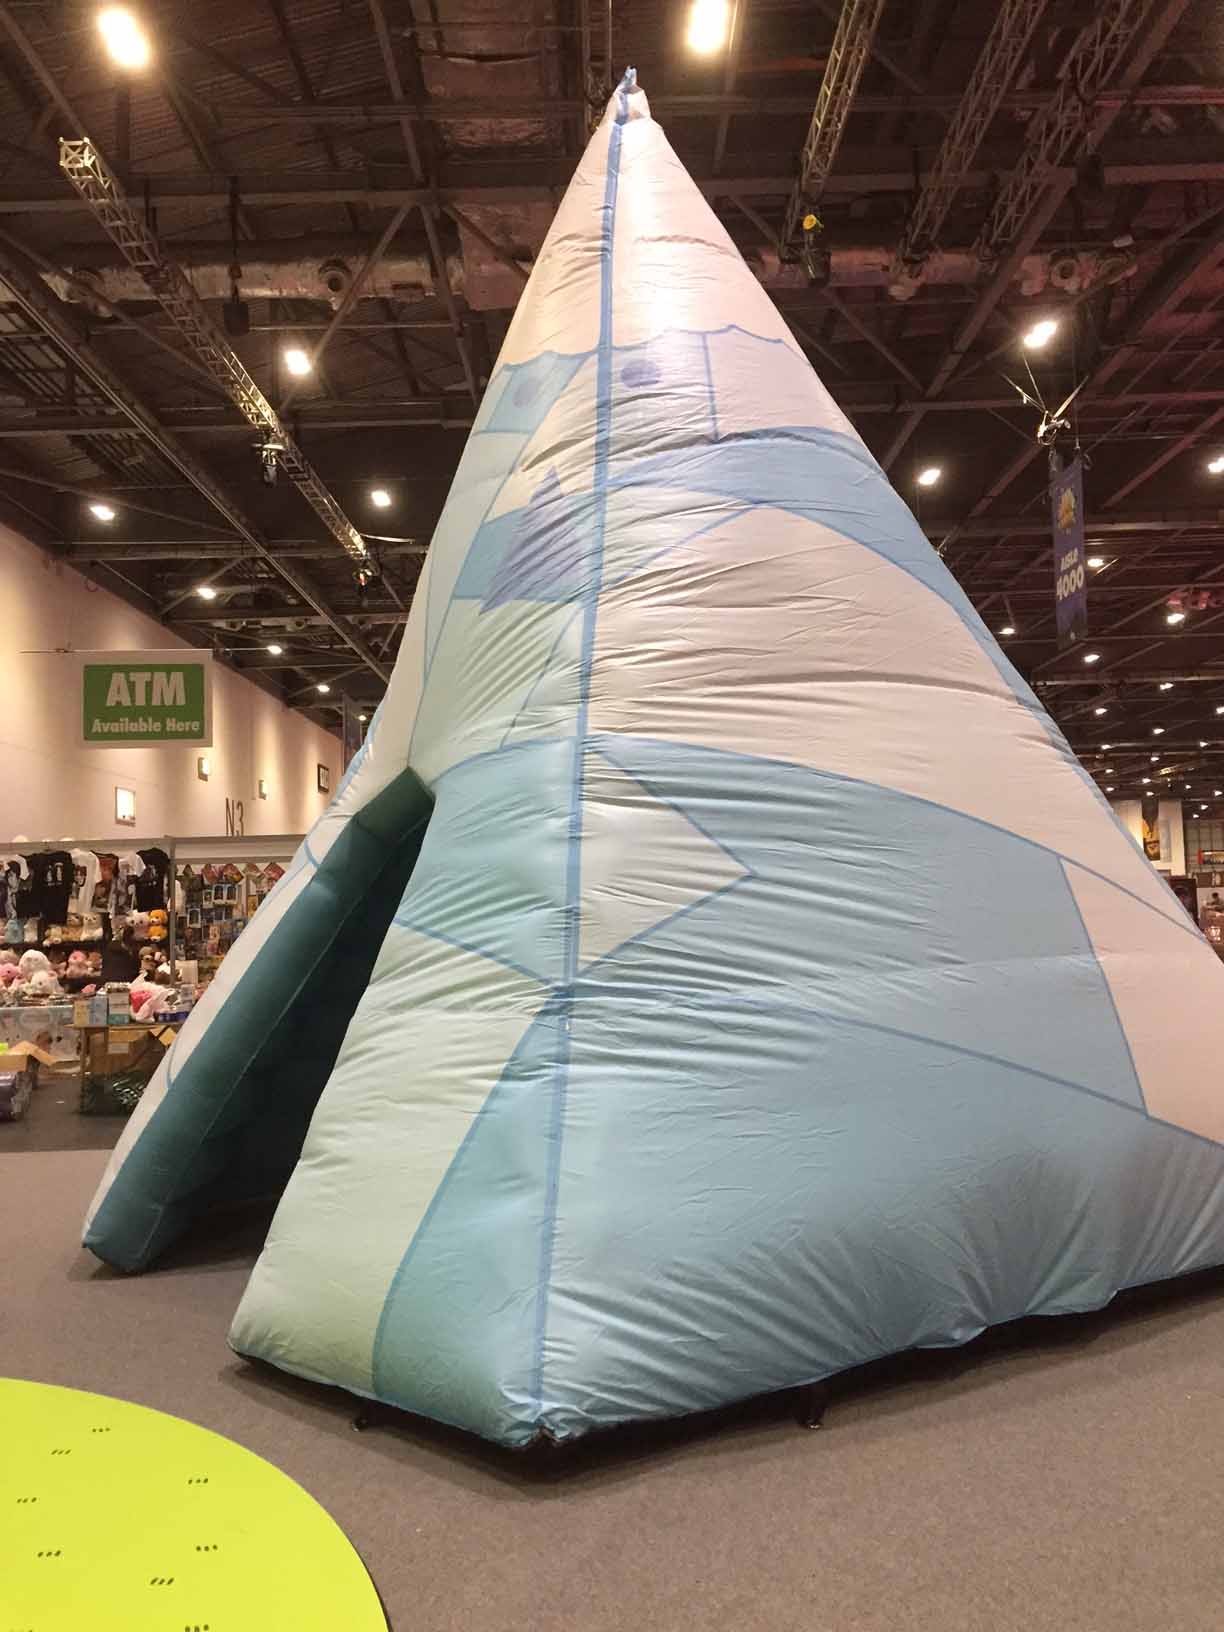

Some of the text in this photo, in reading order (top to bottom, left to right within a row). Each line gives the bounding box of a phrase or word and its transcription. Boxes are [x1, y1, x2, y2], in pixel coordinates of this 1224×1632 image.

[1056, 564, 1084, 600] 4000
[106, 671, 186, 707] ATM
[91, 717, 200, 733] Available Here
[225, 797, 244, 836] N3
